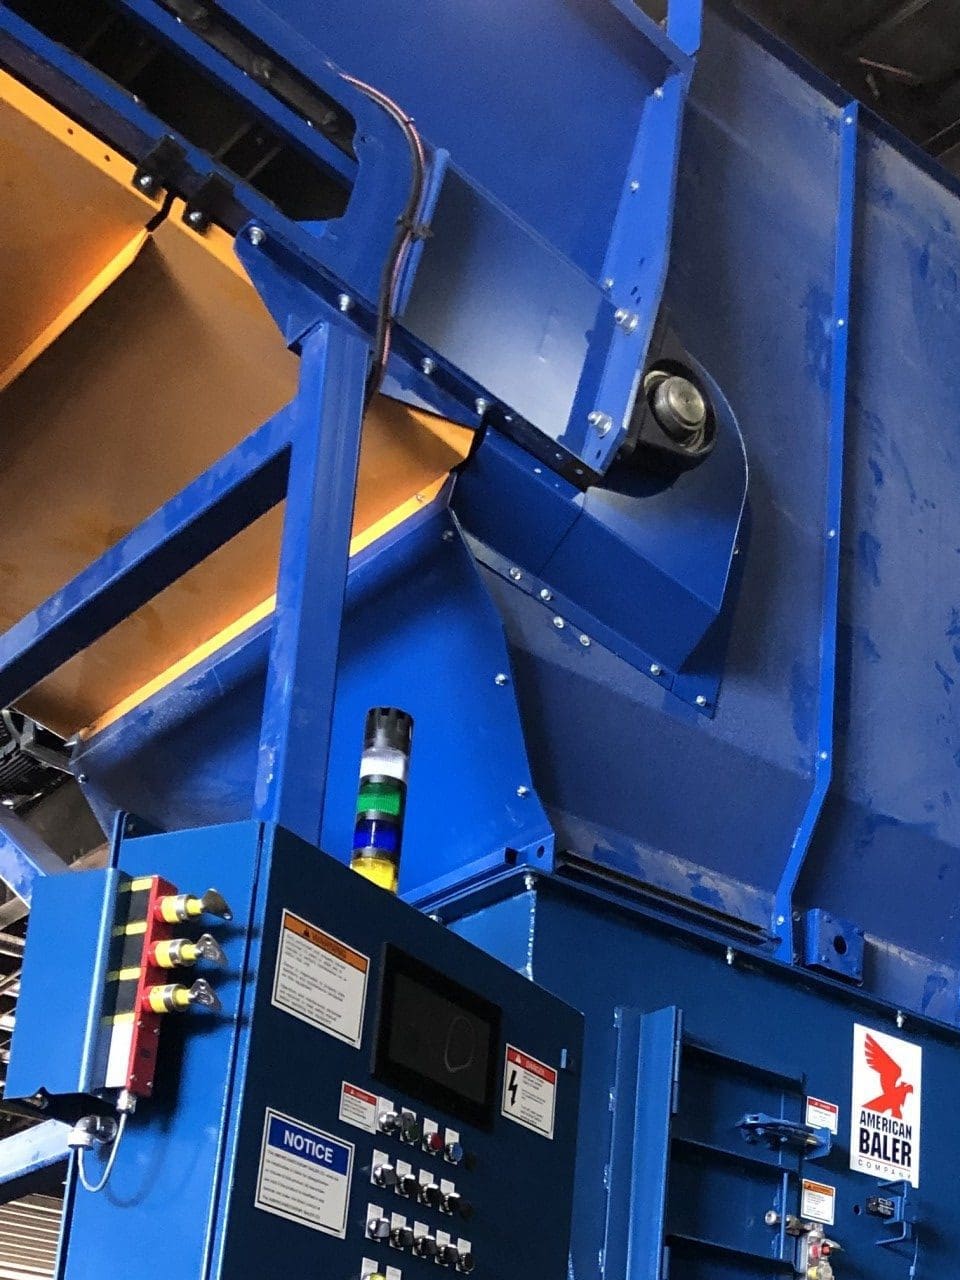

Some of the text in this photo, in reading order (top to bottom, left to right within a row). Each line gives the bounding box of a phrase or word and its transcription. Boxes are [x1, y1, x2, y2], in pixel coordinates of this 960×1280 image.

[860, 1110, 912, 1140] AMERICAN
[284, 1130, 334, 1164] NOTICE
[859, 1127, 911, 1168] BALER
[858, 1158, 911, 1179] COMPANY
